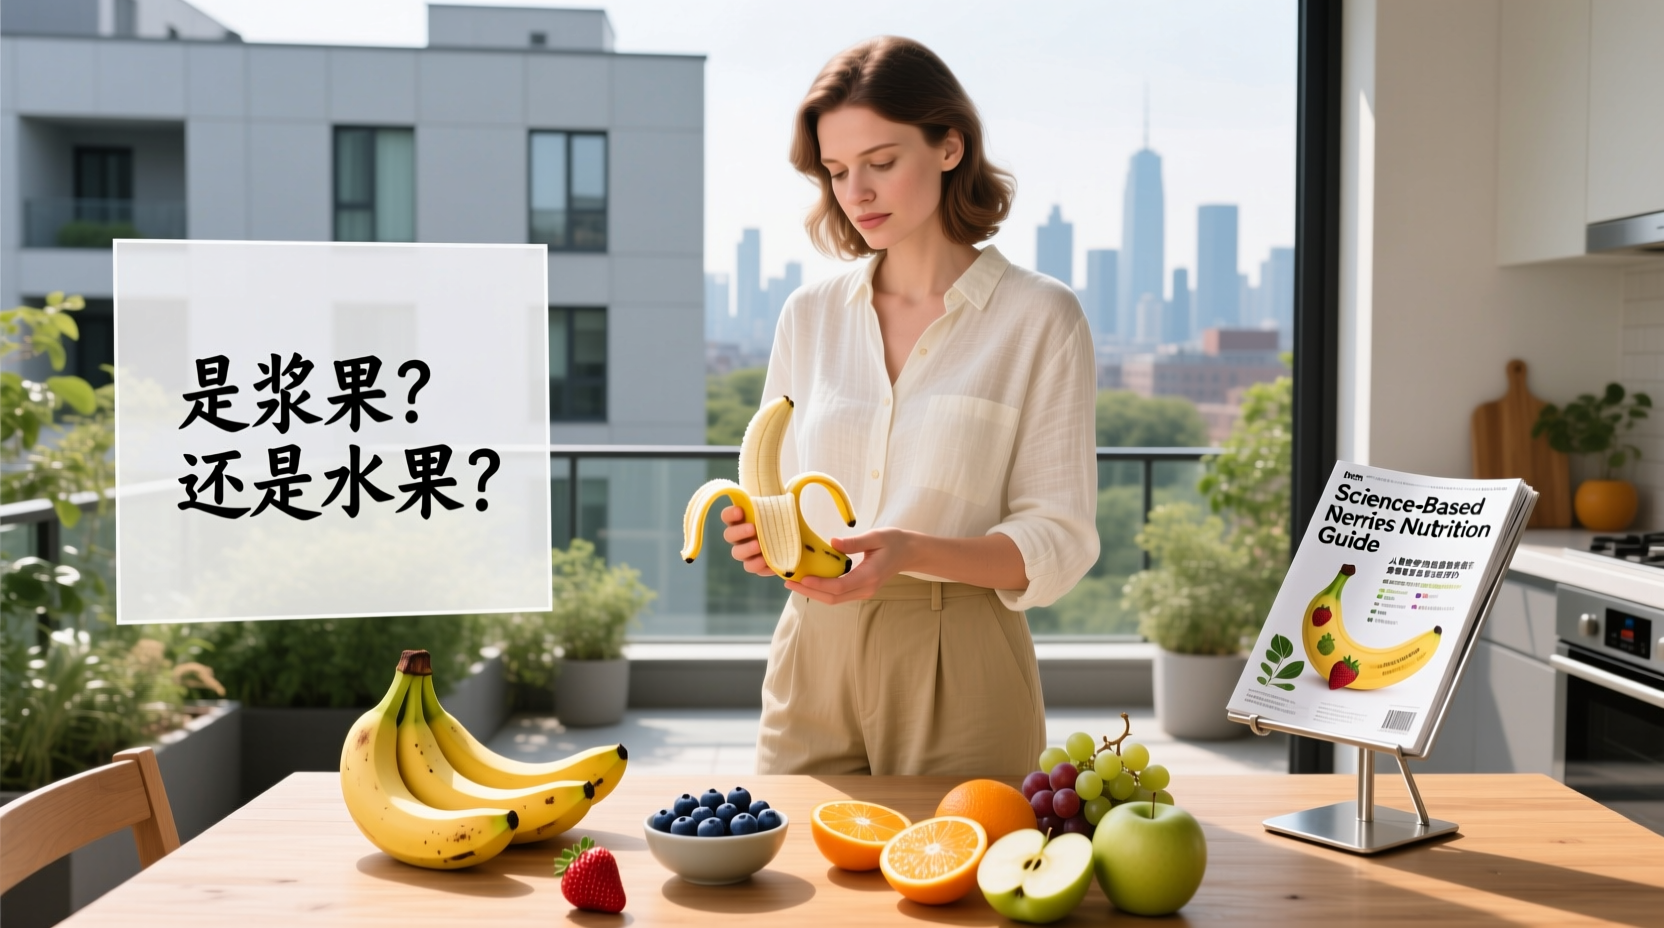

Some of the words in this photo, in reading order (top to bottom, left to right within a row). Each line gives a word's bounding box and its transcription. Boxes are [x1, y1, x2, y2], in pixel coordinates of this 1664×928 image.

[1334, 484, 1486, 516] Science-Based
[1318, 526, 1380, 553] Guide
[1399, 517, 1492, 538] Nutrition
